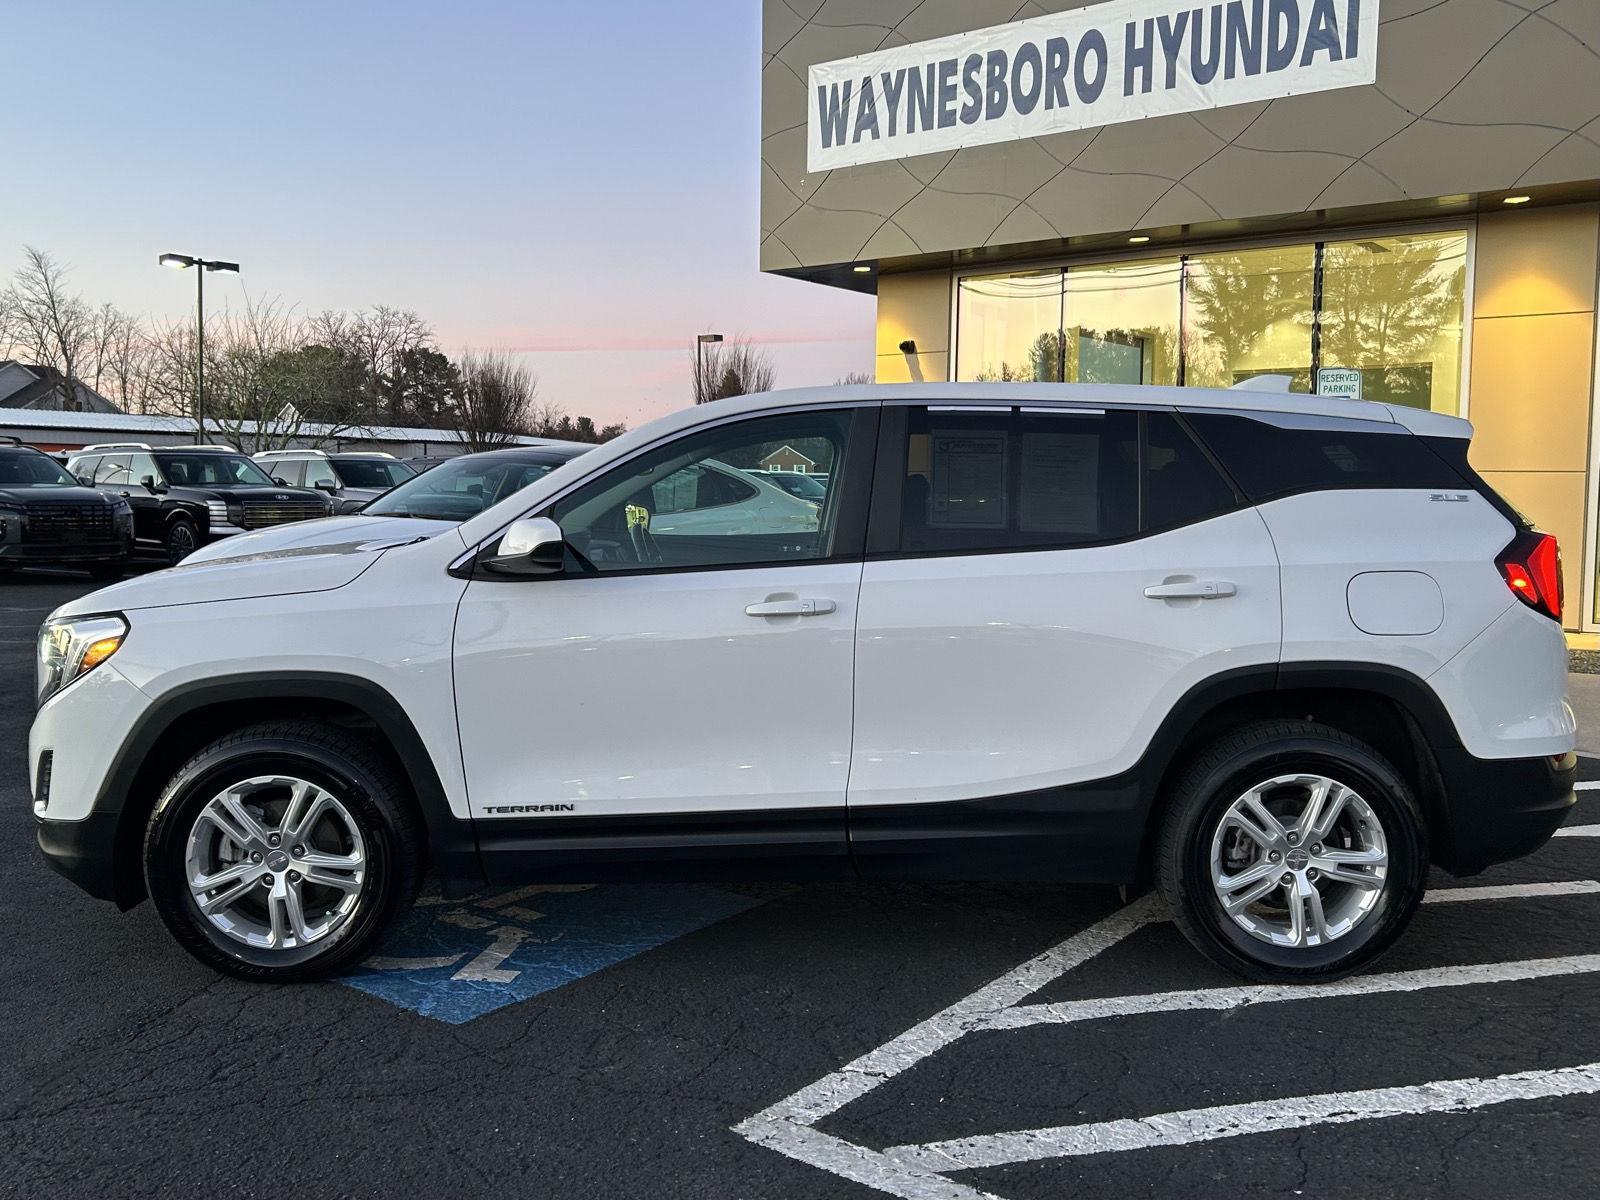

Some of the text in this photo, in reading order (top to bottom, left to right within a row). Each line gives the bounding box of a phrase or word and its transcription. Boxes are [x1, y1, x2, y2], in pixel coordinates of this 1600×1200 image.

[817, 0, 1363, 149] WAYNESBORO HYUNDAI
[1320, 373, 1359, 382] RESERVED
[1323, 384, 1356, 393] PARKING
[482, 804, 575, 814] TERRAIN
